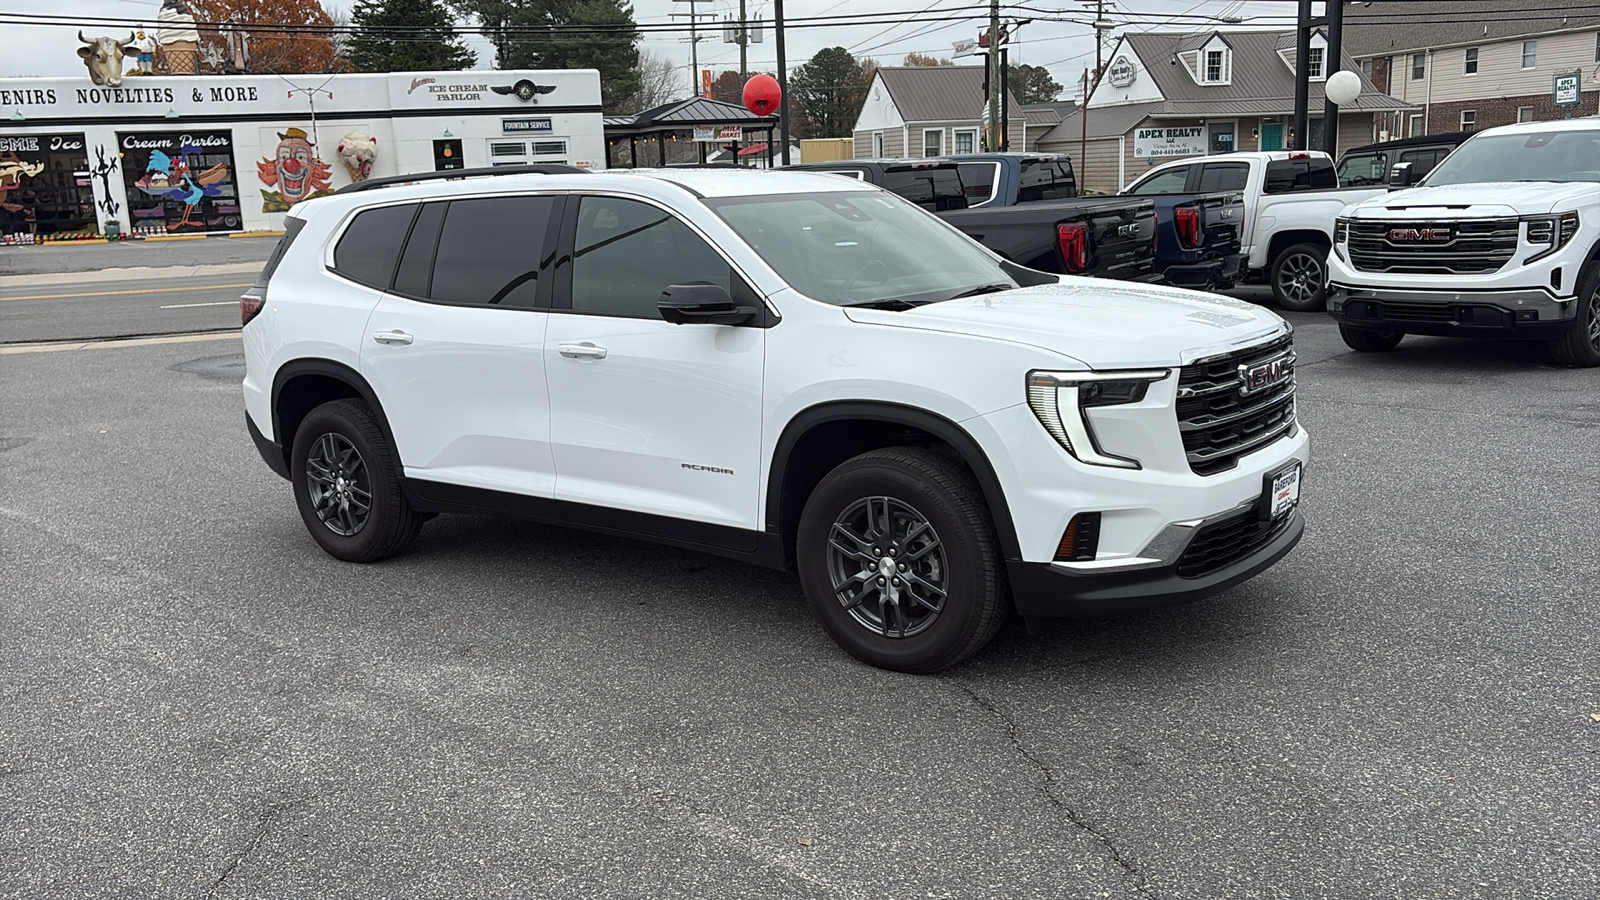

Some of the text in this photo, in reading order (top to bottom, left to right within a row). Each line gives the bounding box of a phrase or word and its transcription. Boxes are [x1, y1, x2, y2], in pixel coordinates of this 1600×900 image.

[428, 84, 488, 93] ICE CREAM
[0, 87, 258, 105] ENIRS NOVELTIES & MORE
[437, 93, 481, 101] PARLOR
[504, 121, 551, 130] FOUNTAIN SERVICE
[1138, 128, 1202, 139] APEX REALTY
[50, 136, 82, 150] Ice
[123, 134, 229, 149] Cream Parlor
[1390, 228, 1450, 241] GMC
[1252, 358, 1288, 388] GMC
[681, 463, 734, 475] ACADIA
[1274, 472, 1296, 494] BAREFORD
